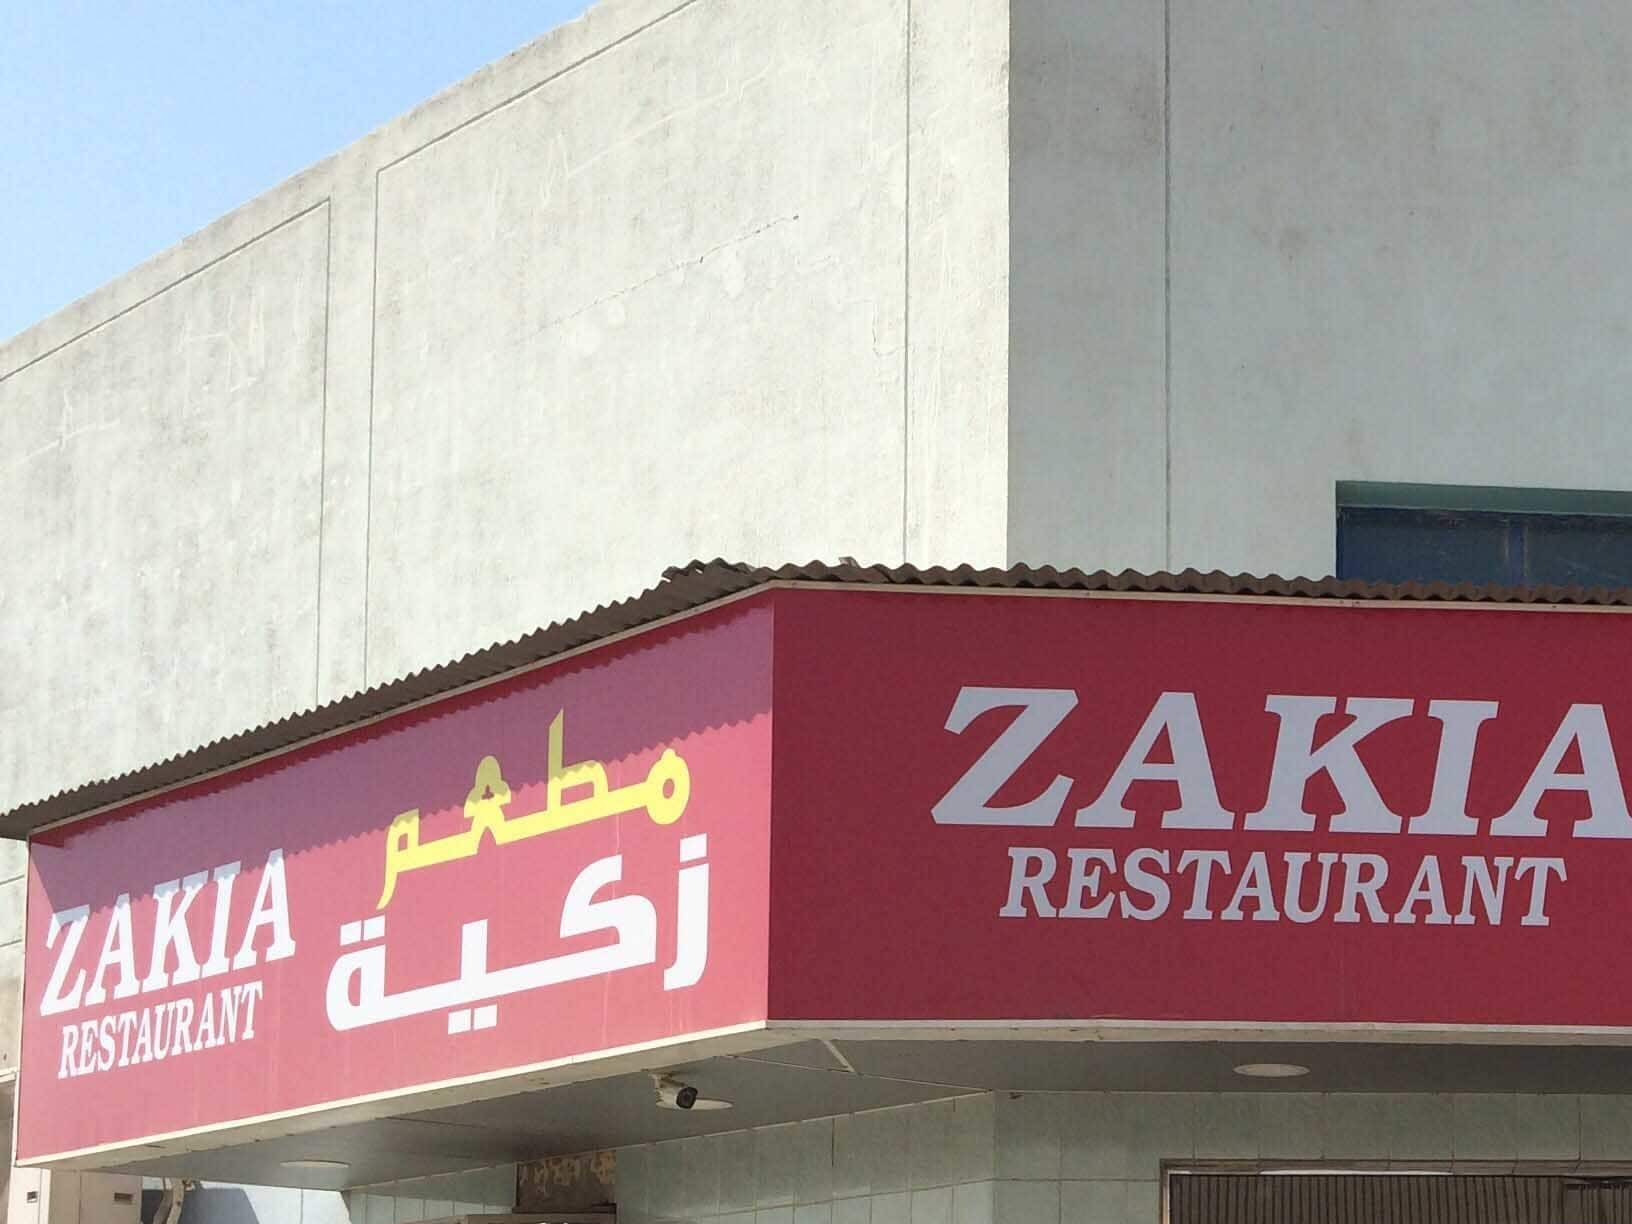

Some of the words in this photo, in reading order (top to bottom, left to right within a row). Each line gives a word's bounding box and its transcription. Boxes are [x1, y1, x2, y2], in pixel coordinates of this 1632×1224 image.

[376, 708, 691, 910] مطعم
[999, 847, 1567, 926] RESTAURANT
[39, 848, 296, 1017] ZAKIA
[325, 833, 711, 1036] زكية
[57, 981, 263, 1080] RESTAURANT
